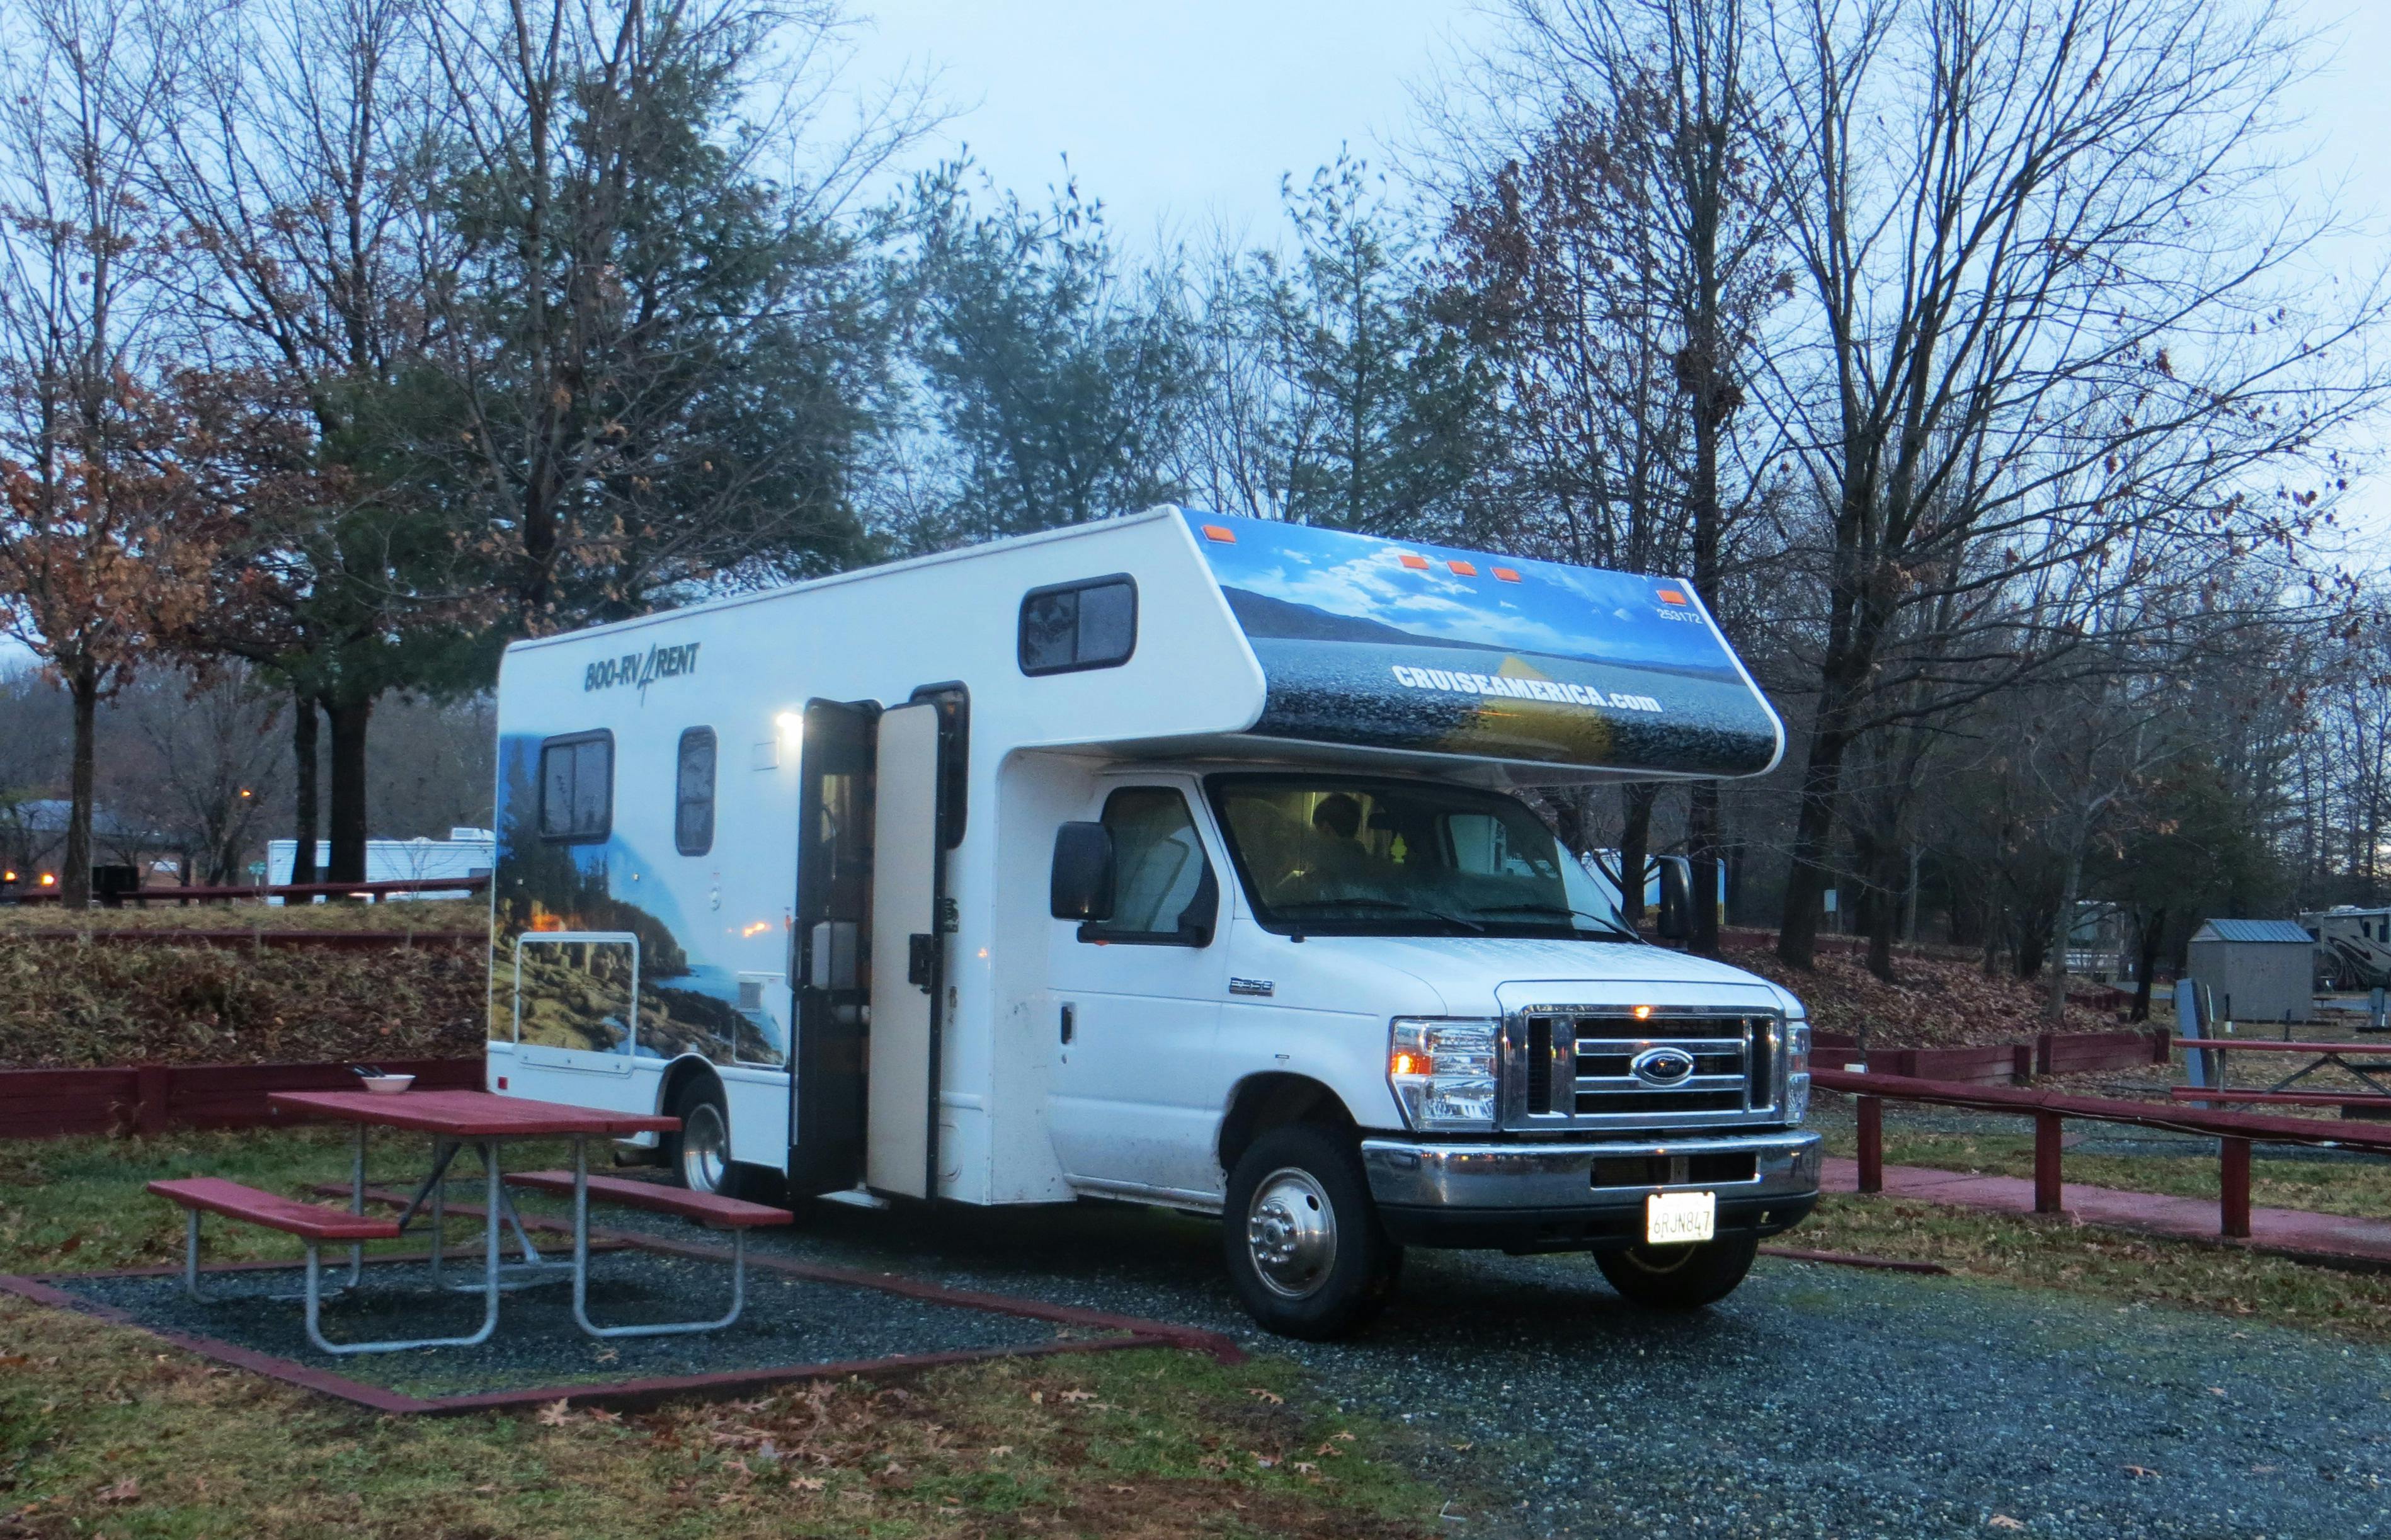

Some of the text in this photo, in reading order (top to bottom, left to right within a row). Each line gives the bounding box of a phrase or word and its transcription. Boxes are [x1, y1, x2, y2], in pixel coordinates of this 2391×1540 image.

[1657, 608, 1703, 624] 253172
[1391, 665, 1663, 712] CRUISEAMERICA.com
[1654, 1211, 1711, 1235] 6RJN847
